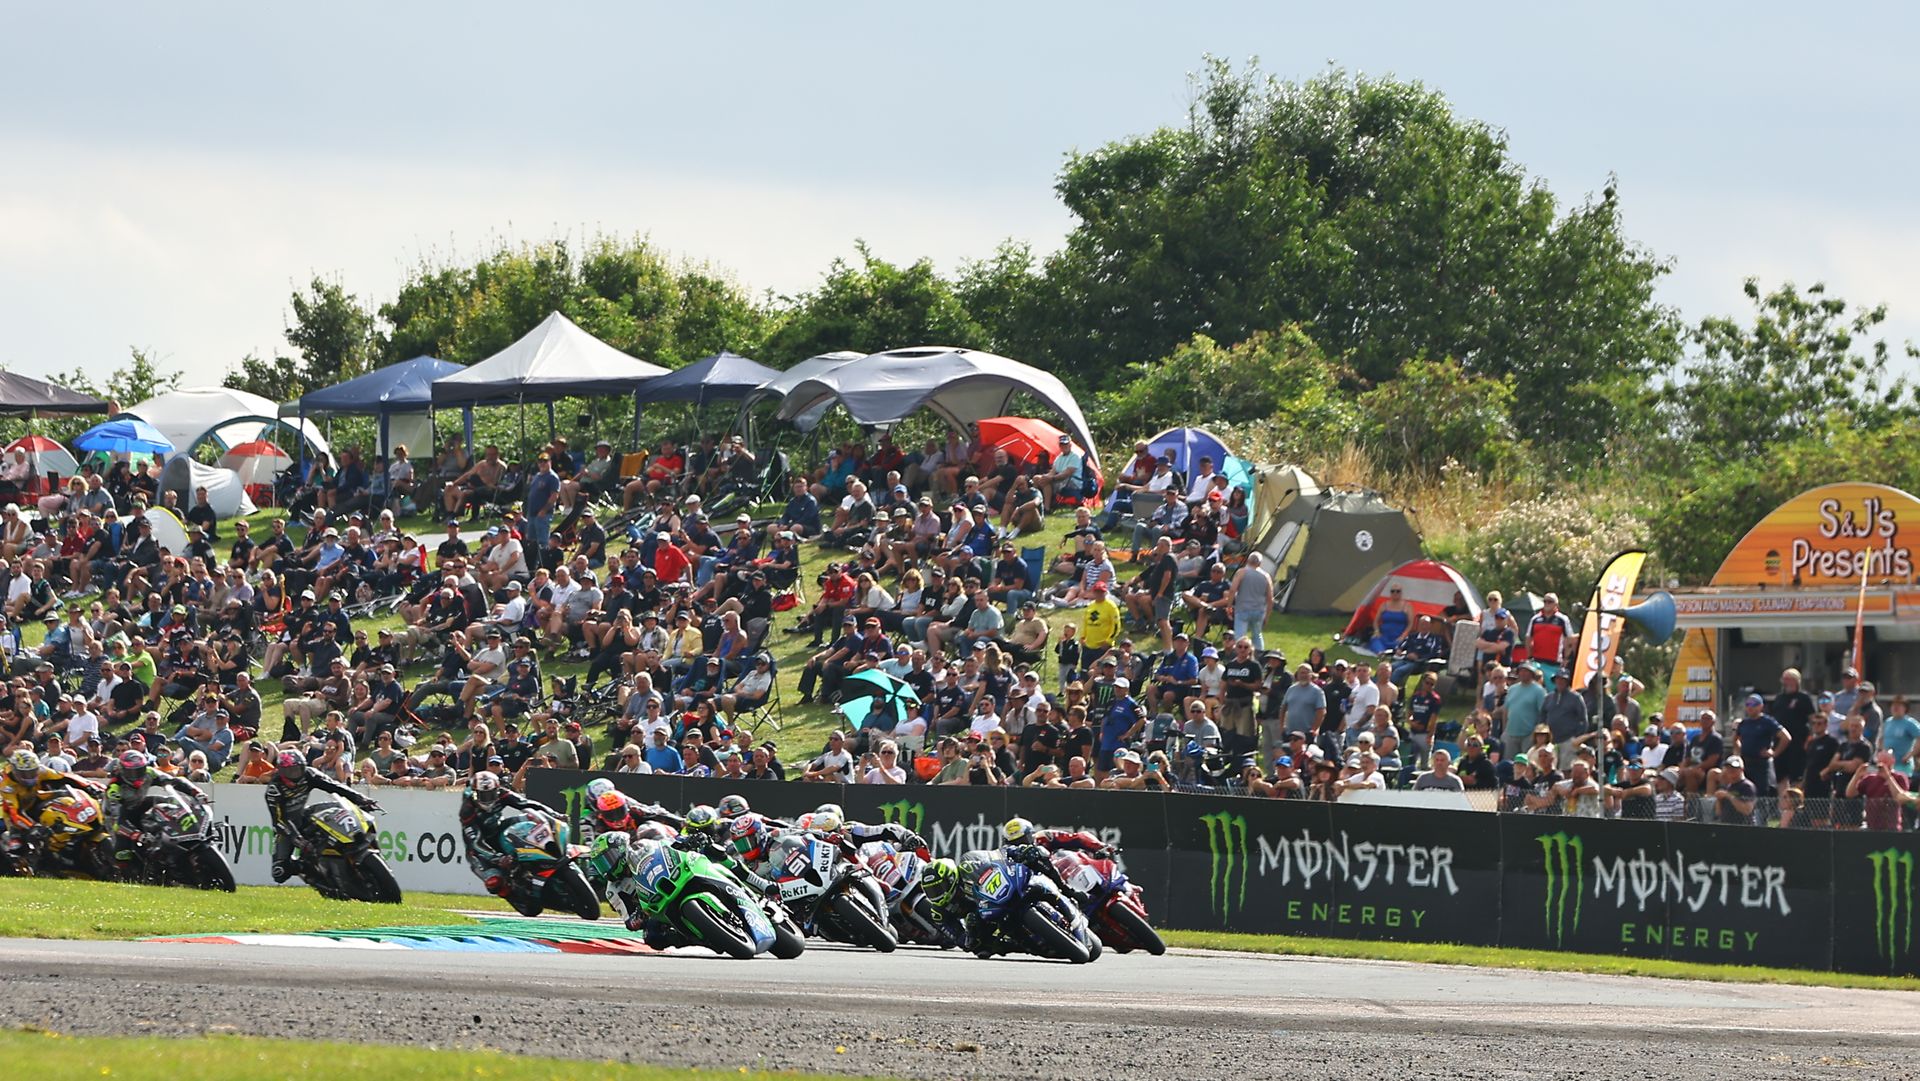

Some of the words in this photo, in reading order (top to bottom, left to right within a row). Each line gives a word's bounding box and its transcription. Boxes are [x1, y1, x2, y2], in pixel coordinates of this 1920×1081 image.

[1819, 497, 1896, 538] S&J's
[1791, 537, 1914, 578] Presents
[788, 853, 811, 877] 91
[1257, 829, 1460, 895] MONSTER
[985, 872, 1002, 895] 77
[1593, 849, 1791, 916] MONSTER
[1288, 901, 1425, 927] ENERGY
[1621, 922, 1760, 952] ENERGY
